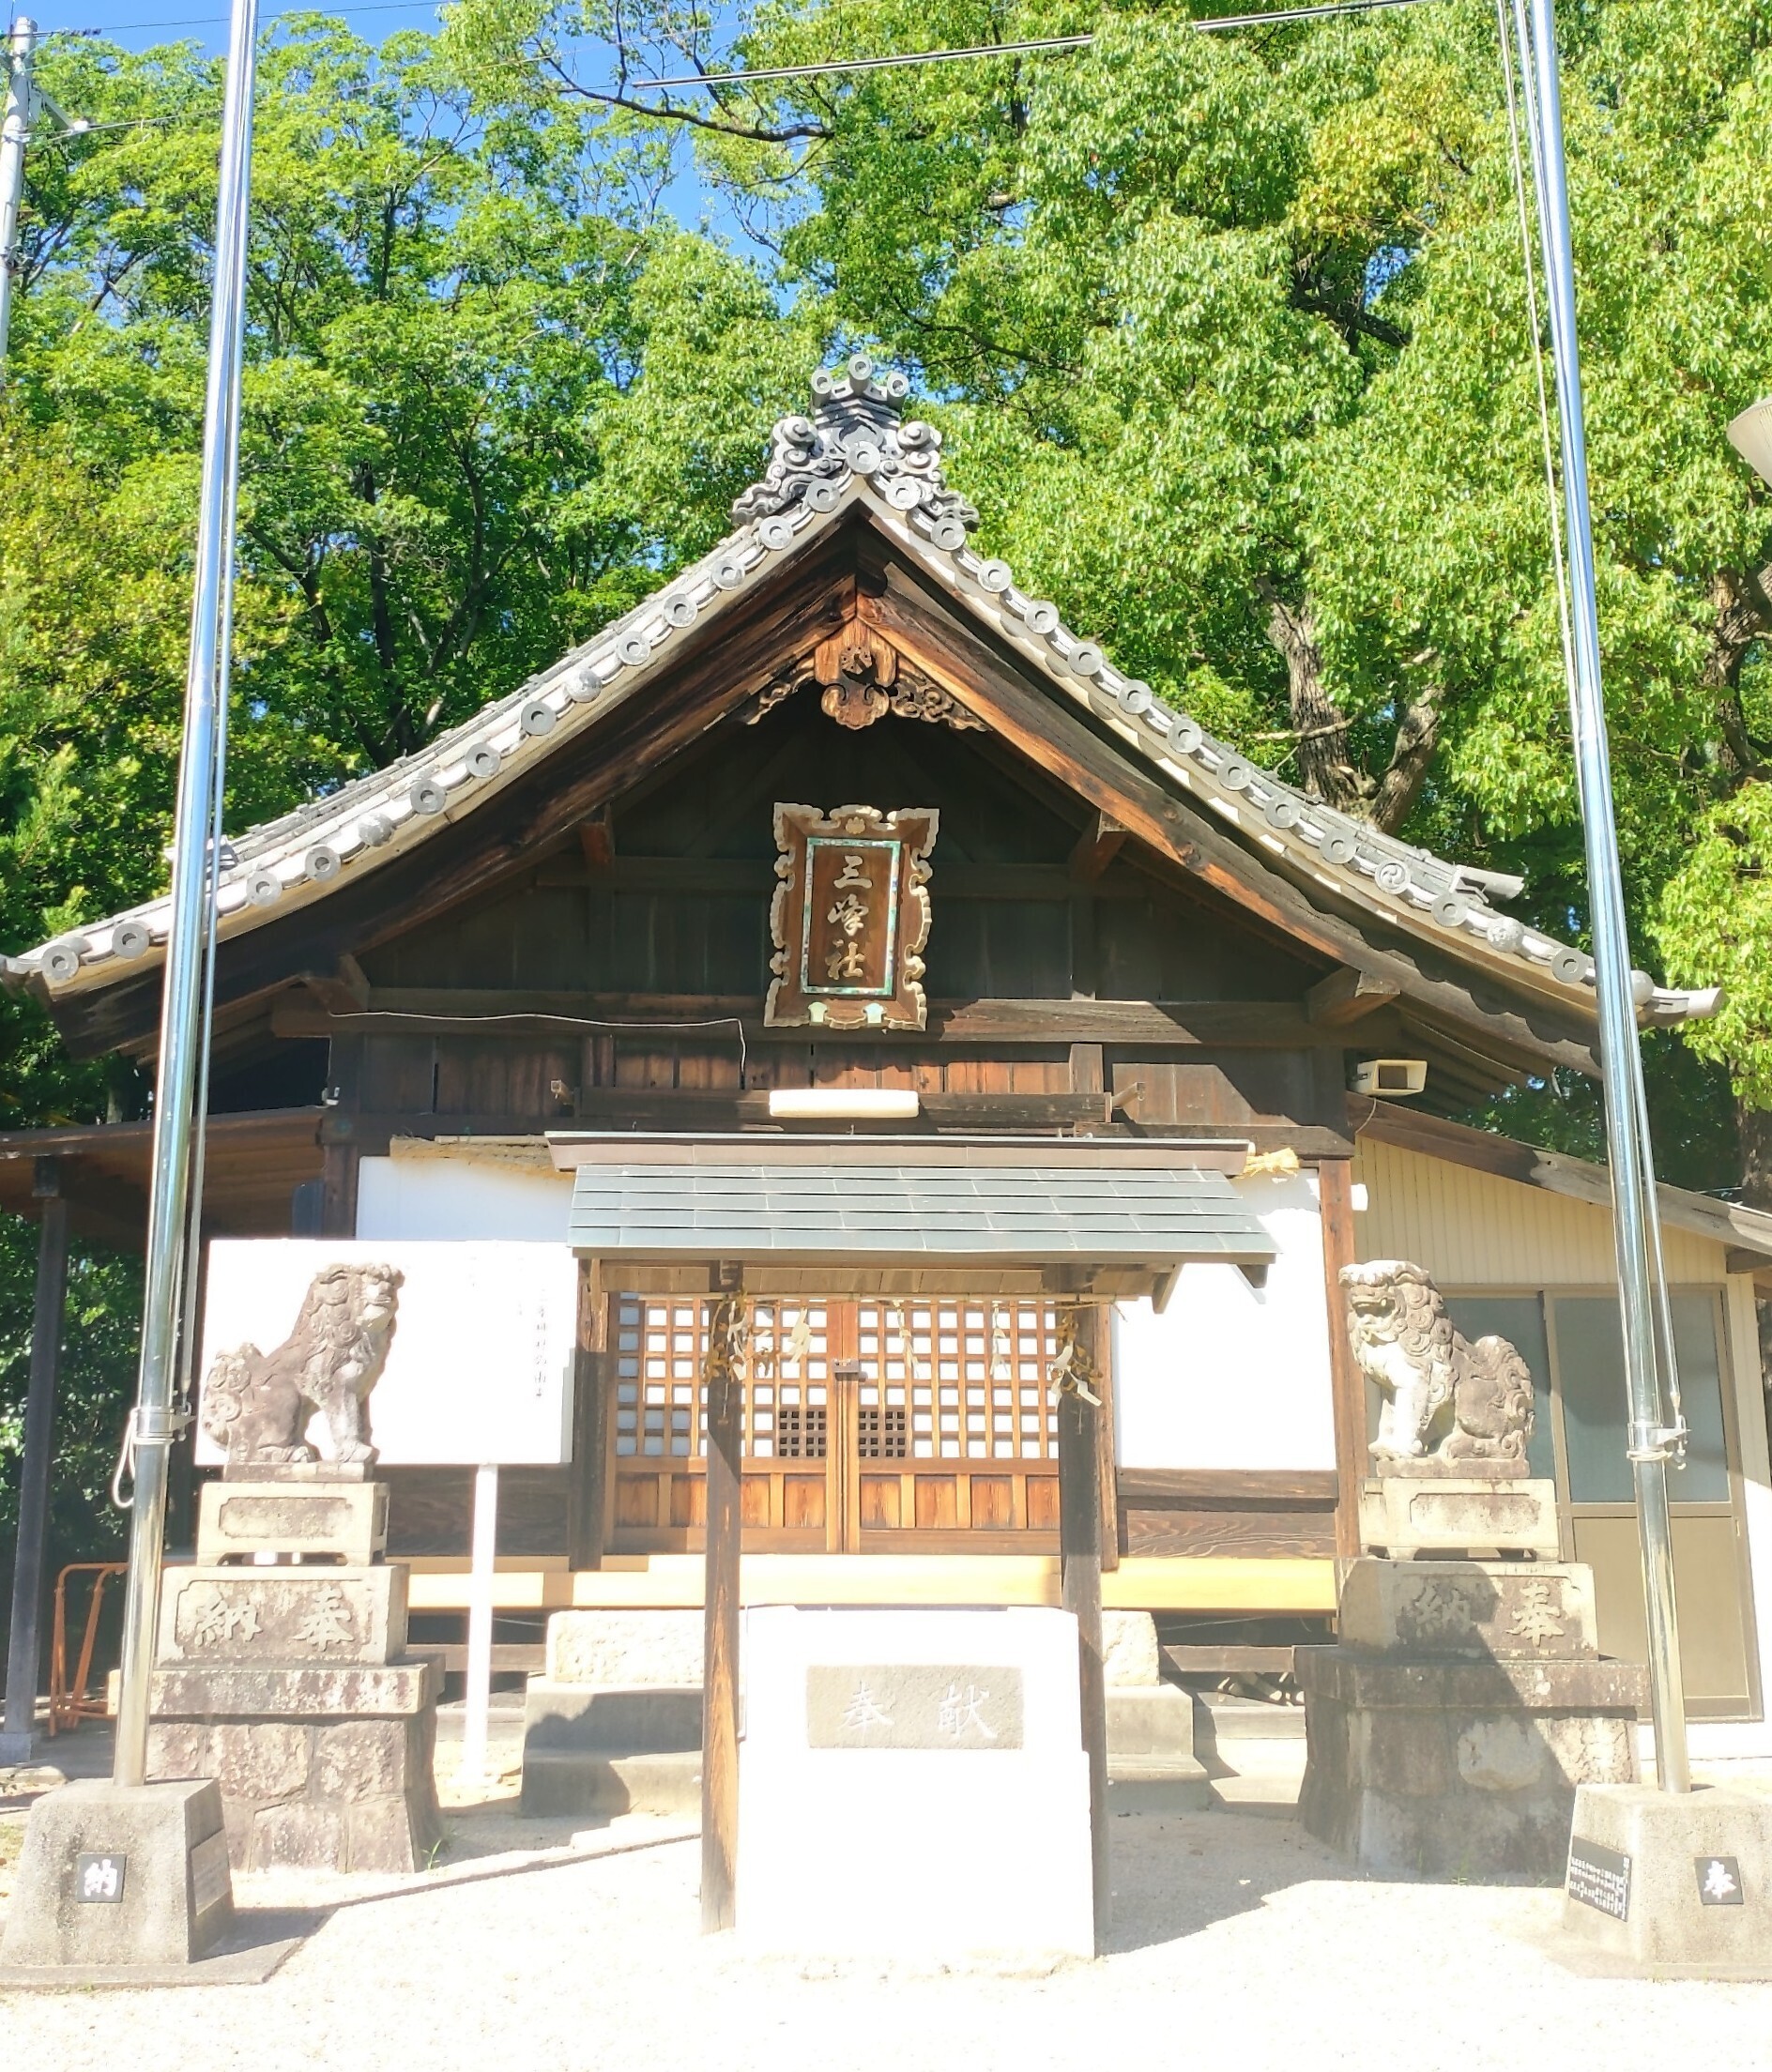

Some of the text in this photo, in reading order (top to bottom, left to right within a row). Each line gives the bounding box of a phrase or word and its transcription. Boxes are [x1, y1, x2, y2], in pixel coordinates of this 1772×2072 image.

[839, 1680, 998, 1741] 奉献
[84, 1858, 117, 1897] 納
[1703, 1860, 1737, 1899] 奉
